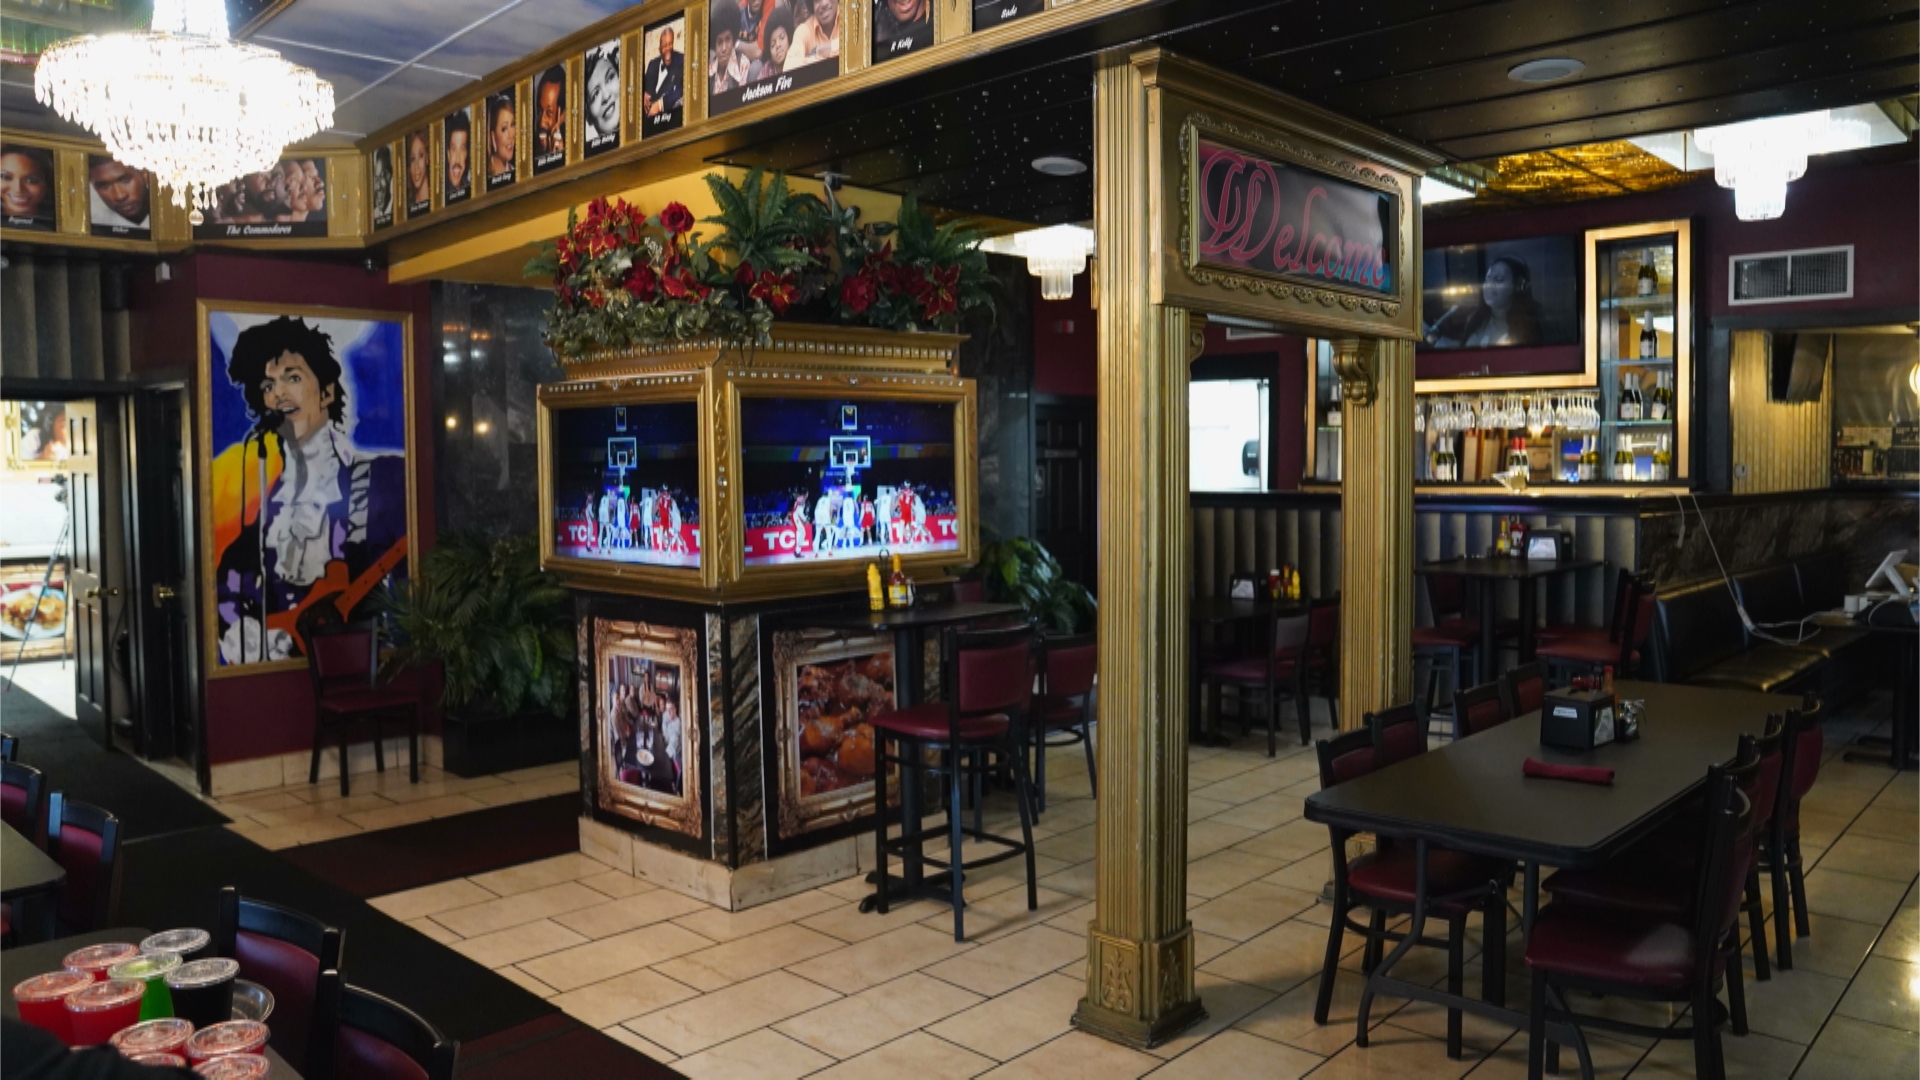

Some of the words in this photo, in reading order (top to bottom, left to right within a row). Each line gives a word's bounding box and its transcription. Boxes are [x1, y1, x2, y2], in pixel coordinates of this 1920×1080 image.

[741, 83, 773, 102] Jackson
[775, 75, 793, 92] Five
[226, 224, 242, 236] The
[1200, 150, 1386, 287] Welcome
